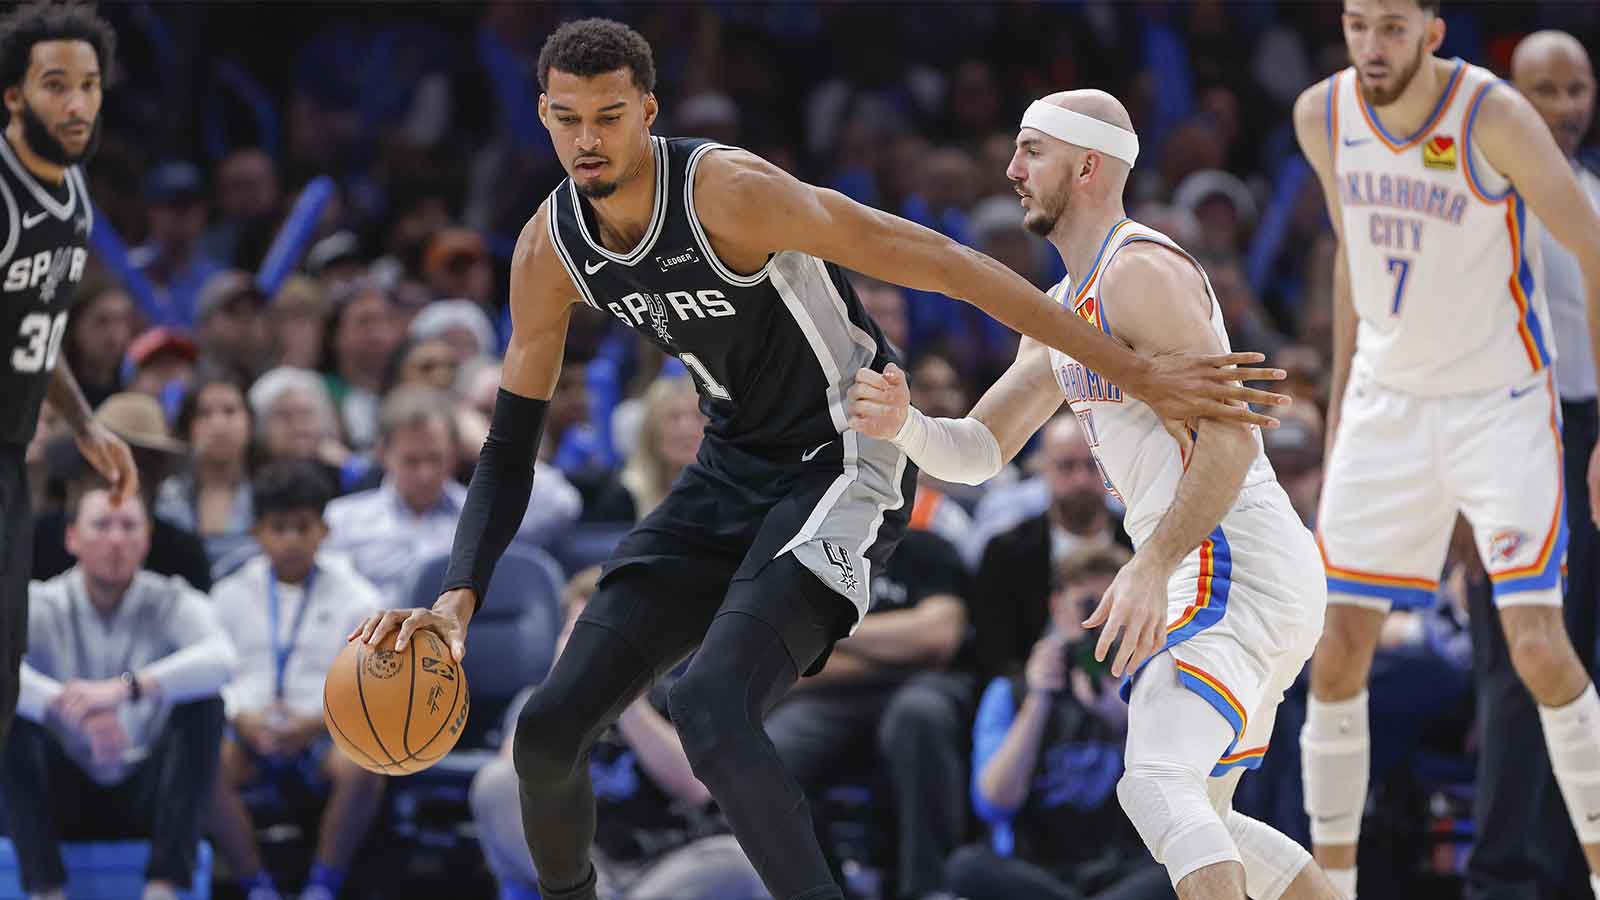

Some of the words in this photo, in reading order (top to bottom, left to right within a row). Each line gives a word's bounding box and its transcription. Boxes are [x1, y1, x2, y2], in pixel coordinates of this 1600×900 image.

[1369, 212, 1423, 252] CITY
[3, 246, 88, 303] SPUR
[662, 253, 693, 268] LEDGER
[1386, 255, 1412, 318] 7
[608, 290, 737, 343] SPURS
[680, 352, 732, 401] 1
